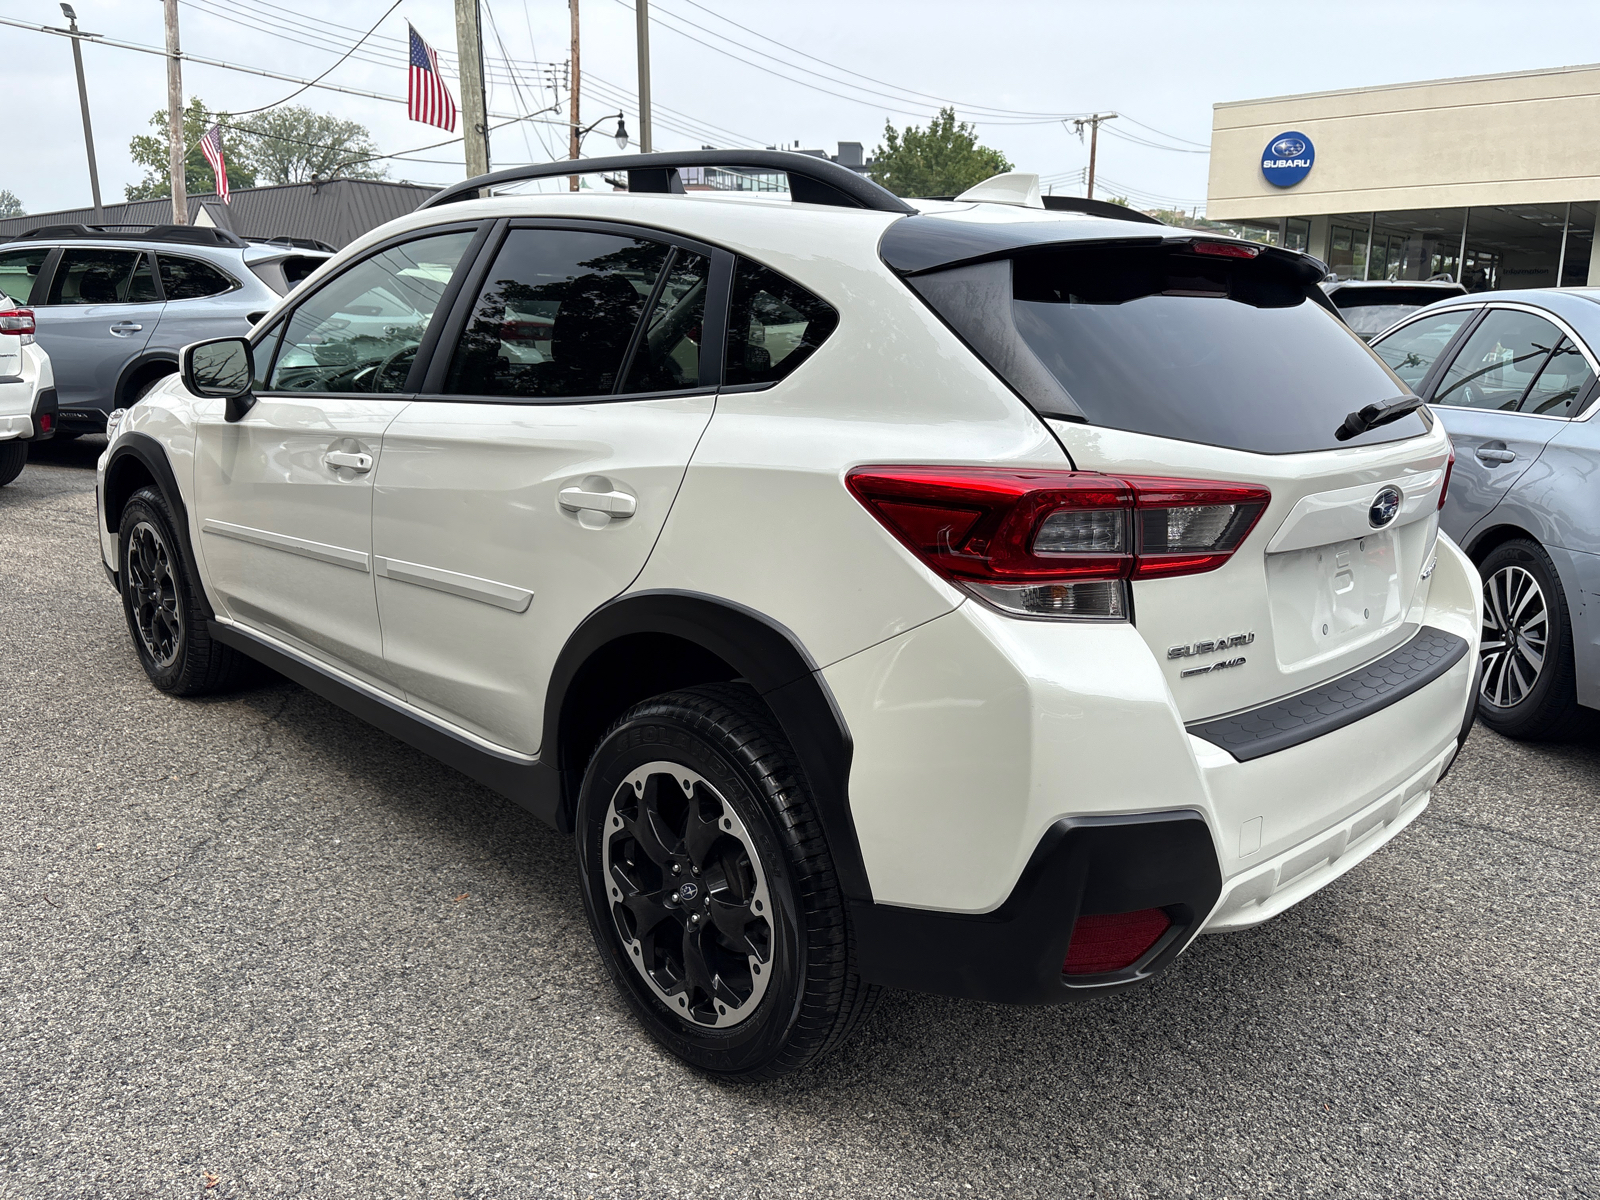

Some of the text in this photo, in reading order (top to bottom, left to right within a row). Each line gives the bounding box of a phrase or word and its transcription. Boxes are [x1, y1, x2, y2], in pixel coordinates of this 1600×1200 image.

[1263, 159, 1310, 168] SUBARU
[1167, 631, 1255, 660] SUBARU
[1208, 656, 1246, 672] AWD
